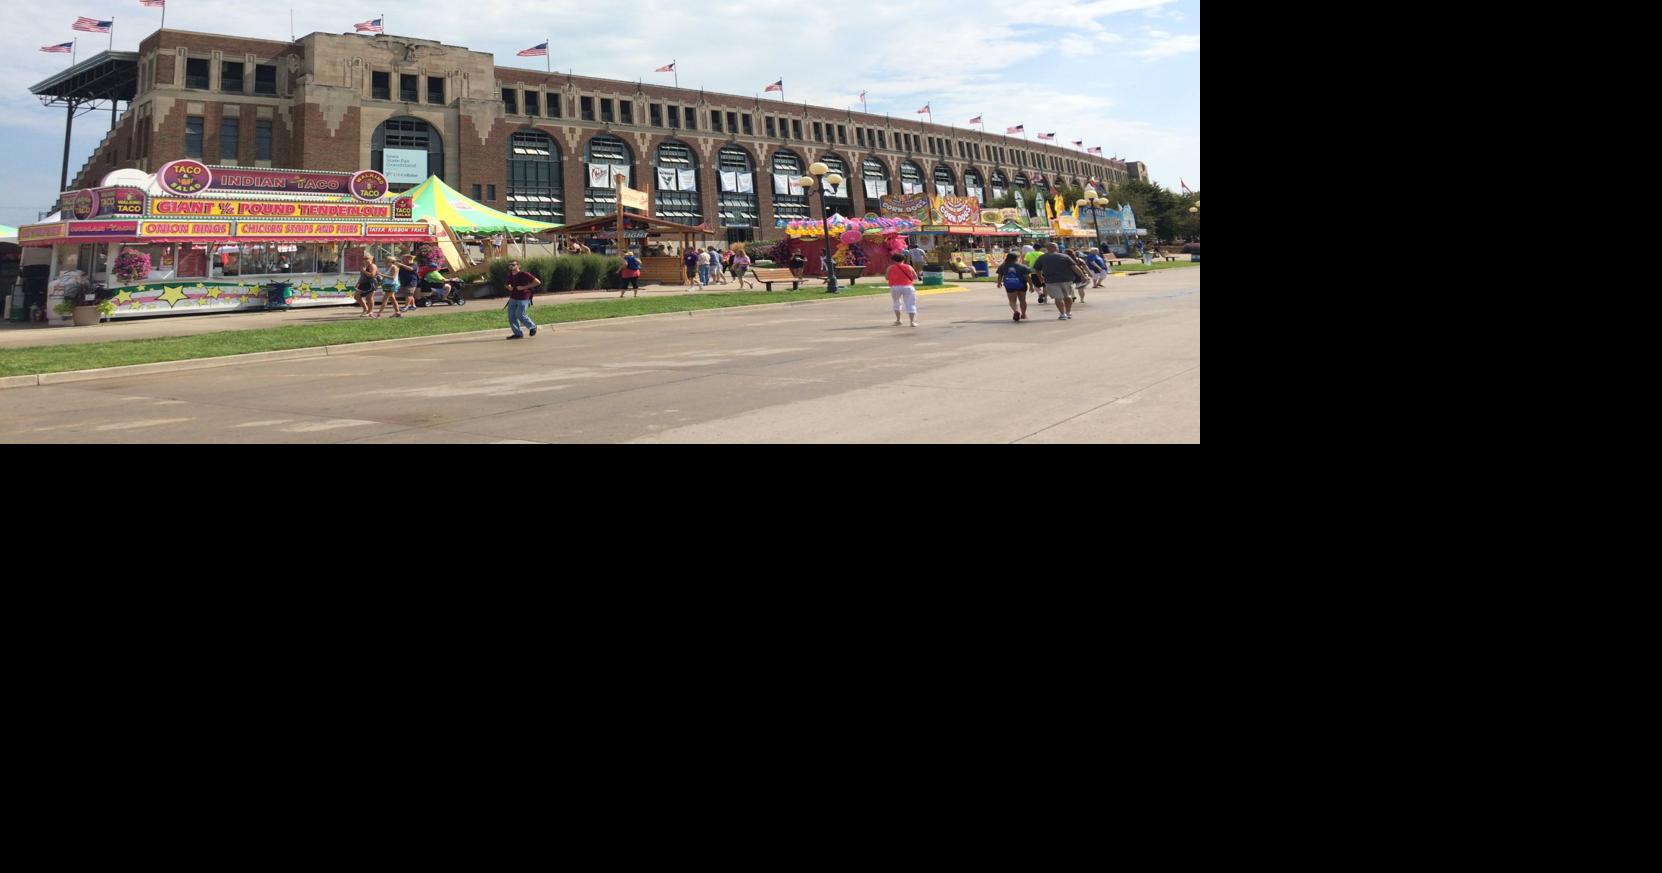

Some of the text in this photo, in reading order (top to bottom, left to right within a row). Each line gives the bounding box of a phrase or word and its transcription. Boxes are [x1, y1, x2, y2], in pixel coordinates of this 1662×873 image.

[173, 165, 201, 174] TACO
[221, 175, 340, 190] INDIAN TACO
[356, 173, 385, 185] WALKING
[170, 182, 201, 192] SALAD
[360, 189, 380, 197] TACO
[117, 205, 142, 213] TACO
[157, 201, 215, 214] GIANT
[239, 203, 296, 216] POUND
[299, 204, 388, 217] TENDERLOIN
[882, 202, 903, 213] CORN
[146, 223, 226, 233] ONION RINGS
[241, 224, 357, 234] CHICKEN STRIPS AND FRIES
